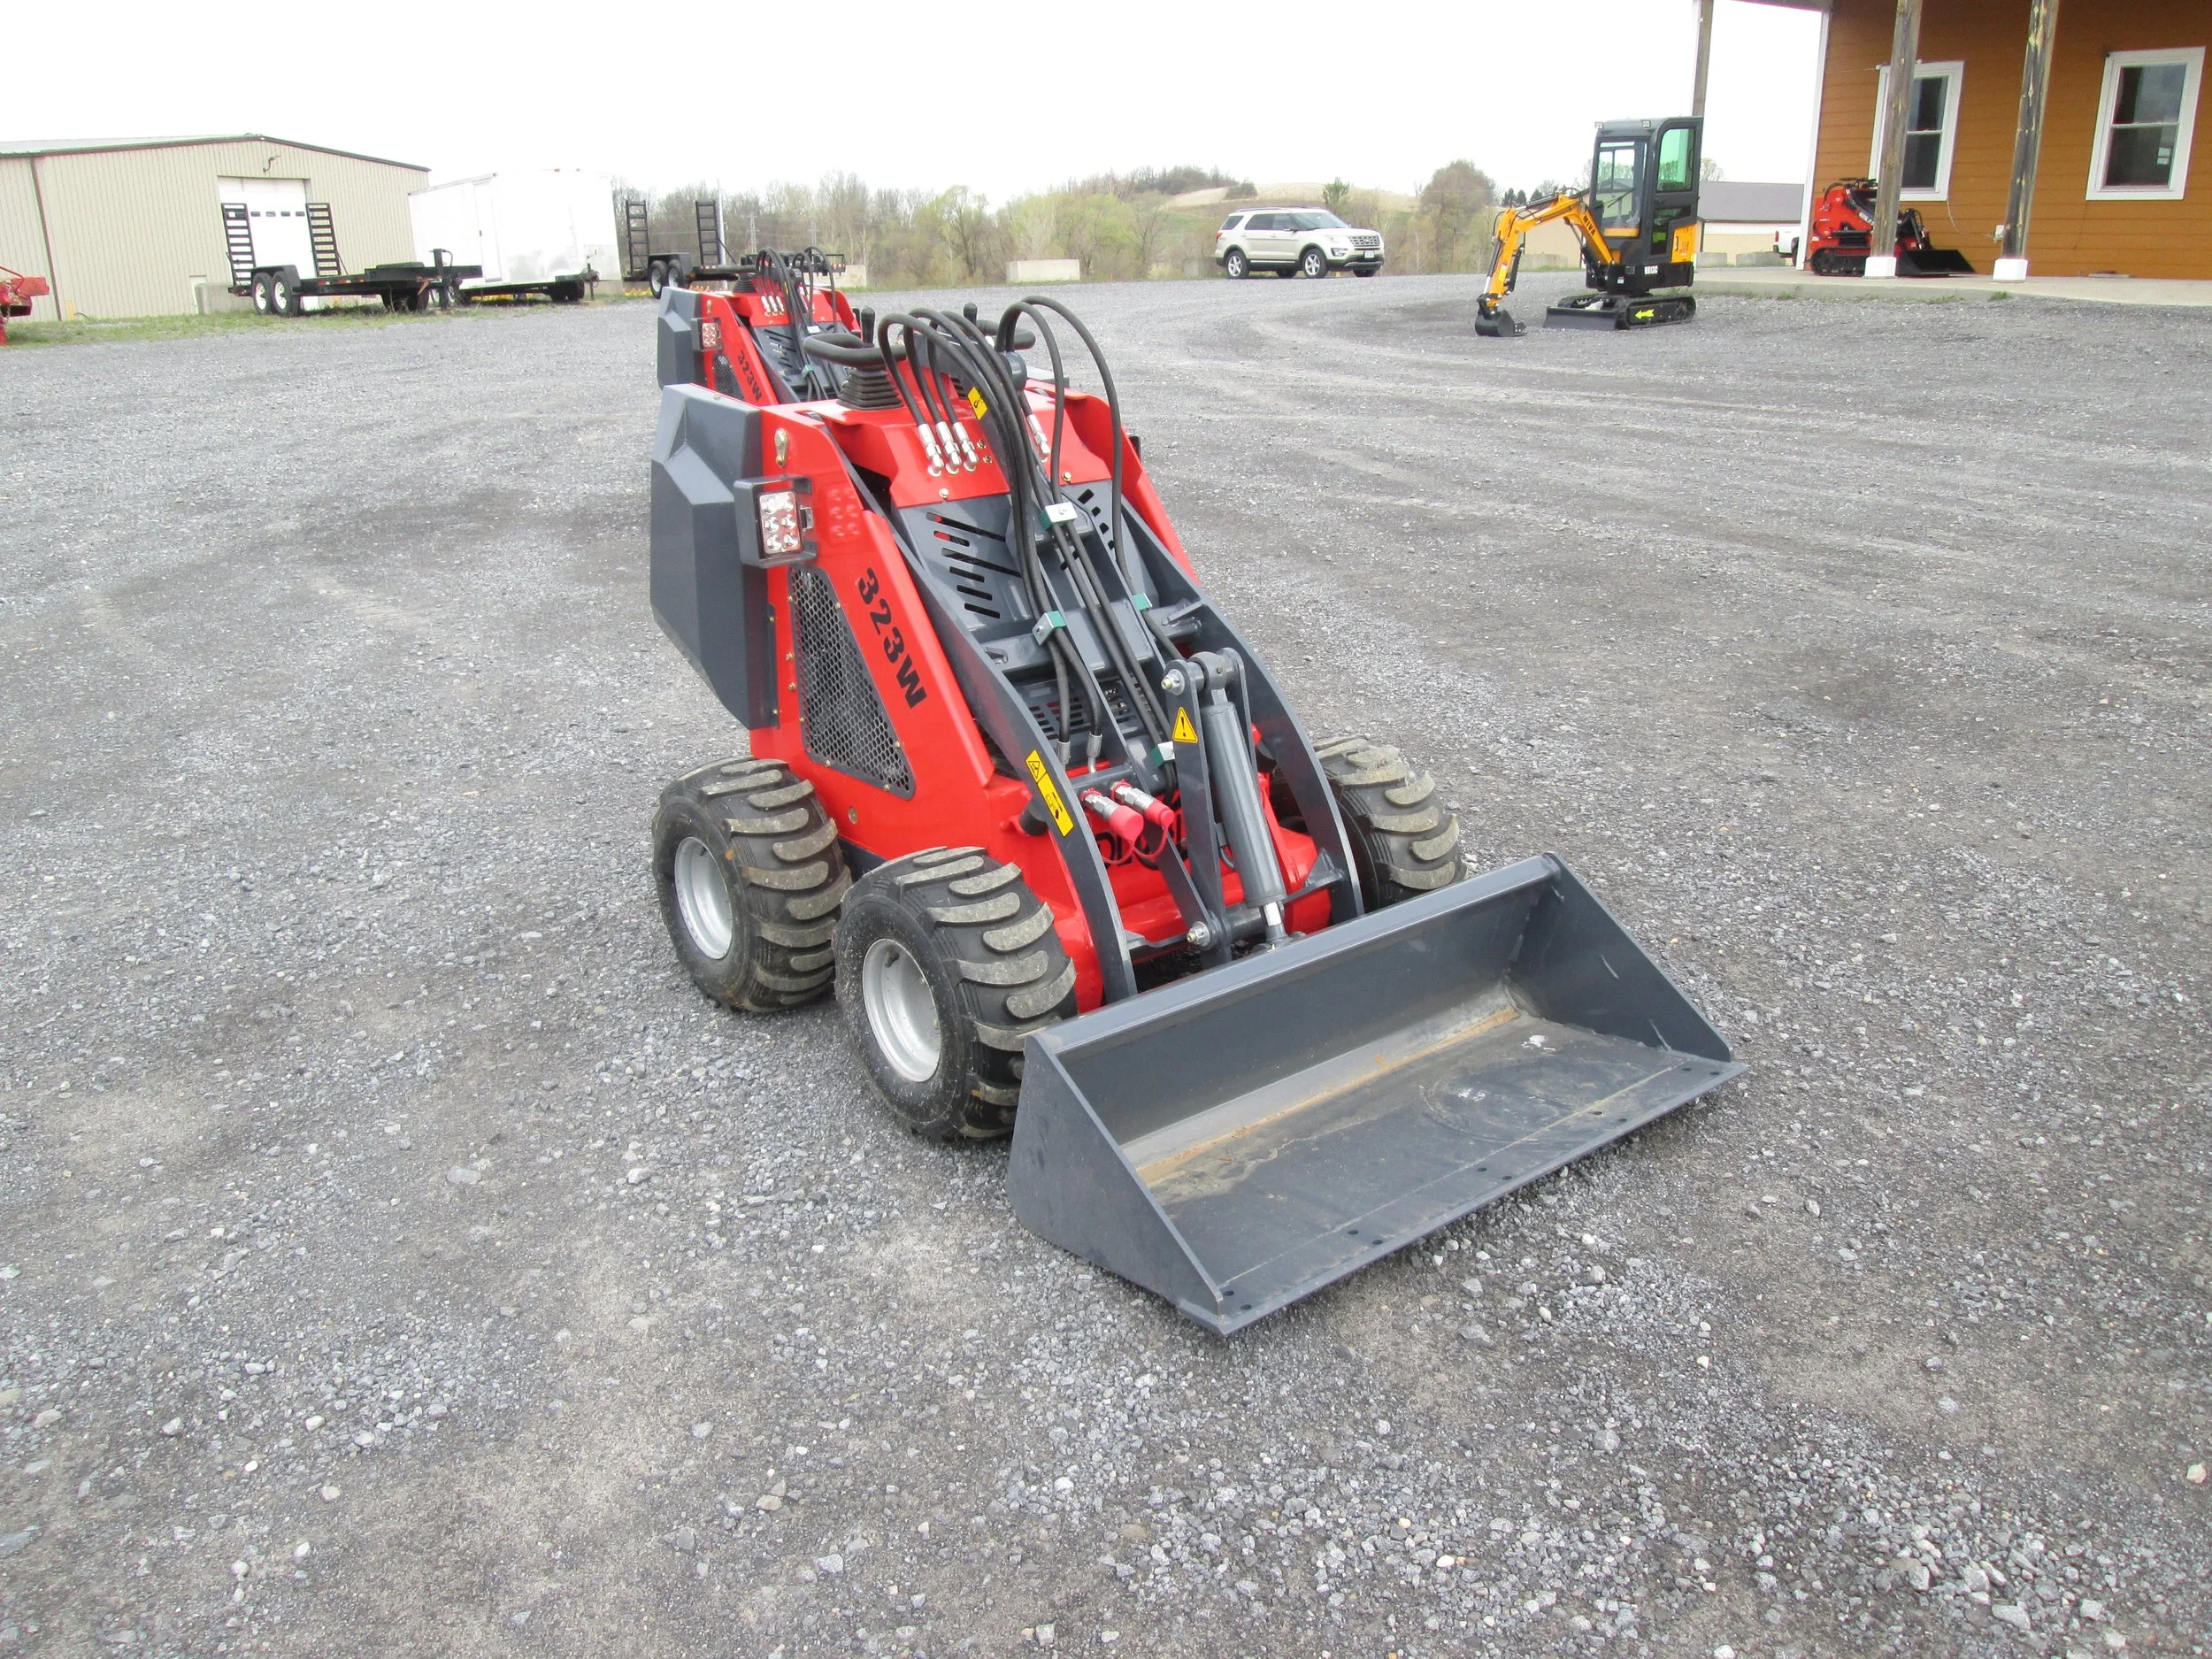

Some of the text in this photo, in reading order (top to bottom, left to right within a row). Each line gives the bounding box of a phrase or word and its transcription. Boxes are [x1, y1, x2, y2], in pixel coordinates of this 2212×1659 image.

[1583, 215, 1596, 235] MIVA
[738, 349, 762, 402] 323W
[857, 567, 927, 709] 323W
